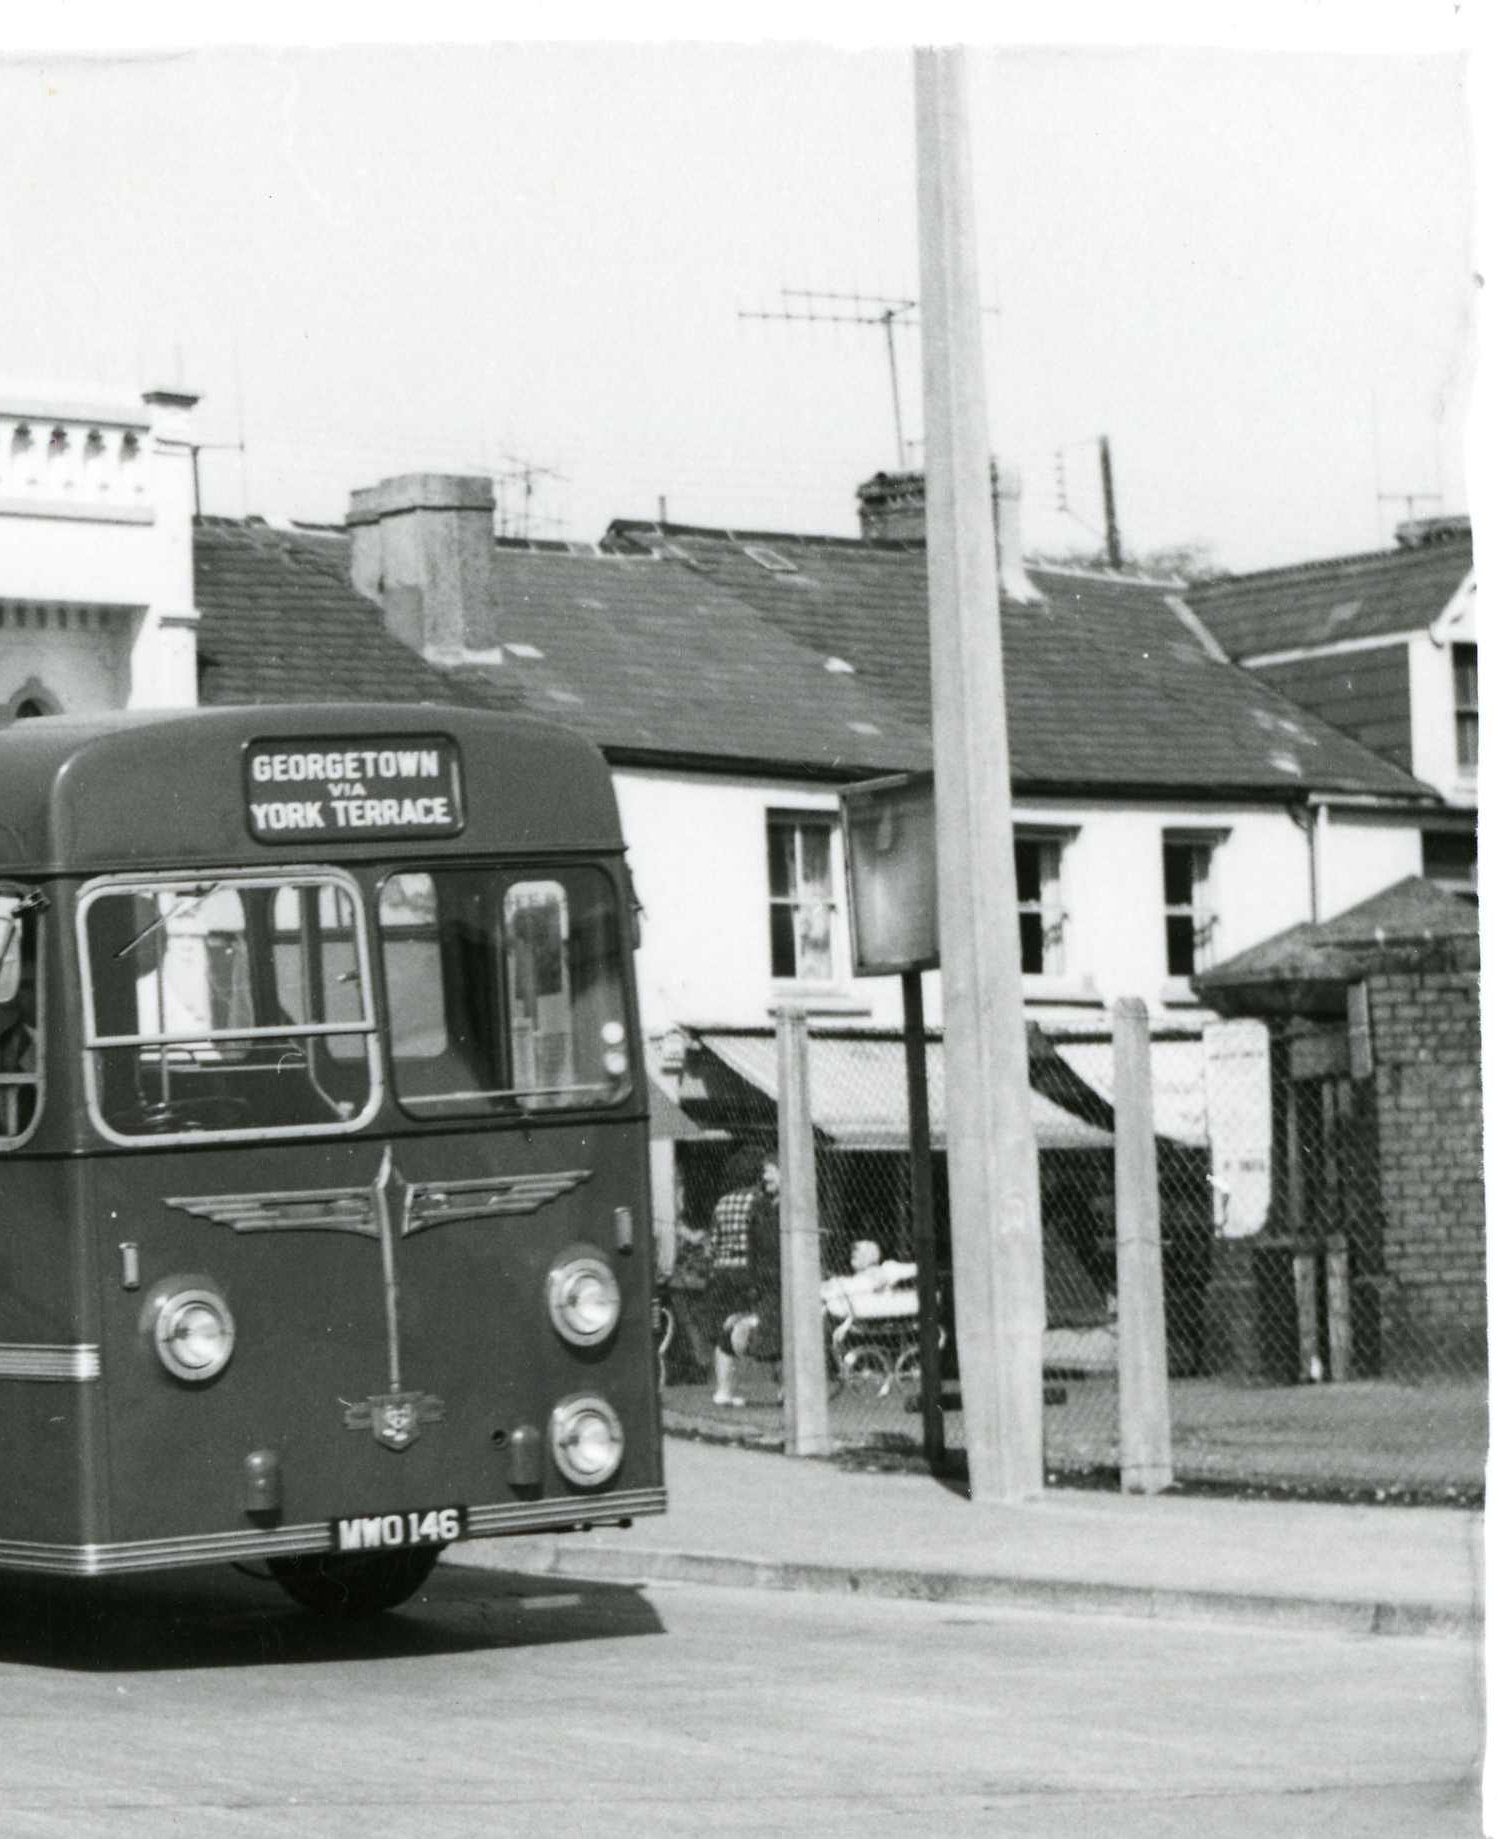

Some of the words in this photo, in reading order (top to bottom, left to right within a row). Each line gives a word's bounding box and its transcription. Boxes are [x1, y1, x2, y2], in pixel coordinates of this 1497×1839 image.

[252, 750, 439, 782] GEORGETOWN
[327, 782, 368, 797] VIA
[250, 801, 326, 830] YORK
[330, 797, 452, 828] TERRACE
[338, 1515, 404, 1550] MWO
[407, 1508, 460, 1544] 146
